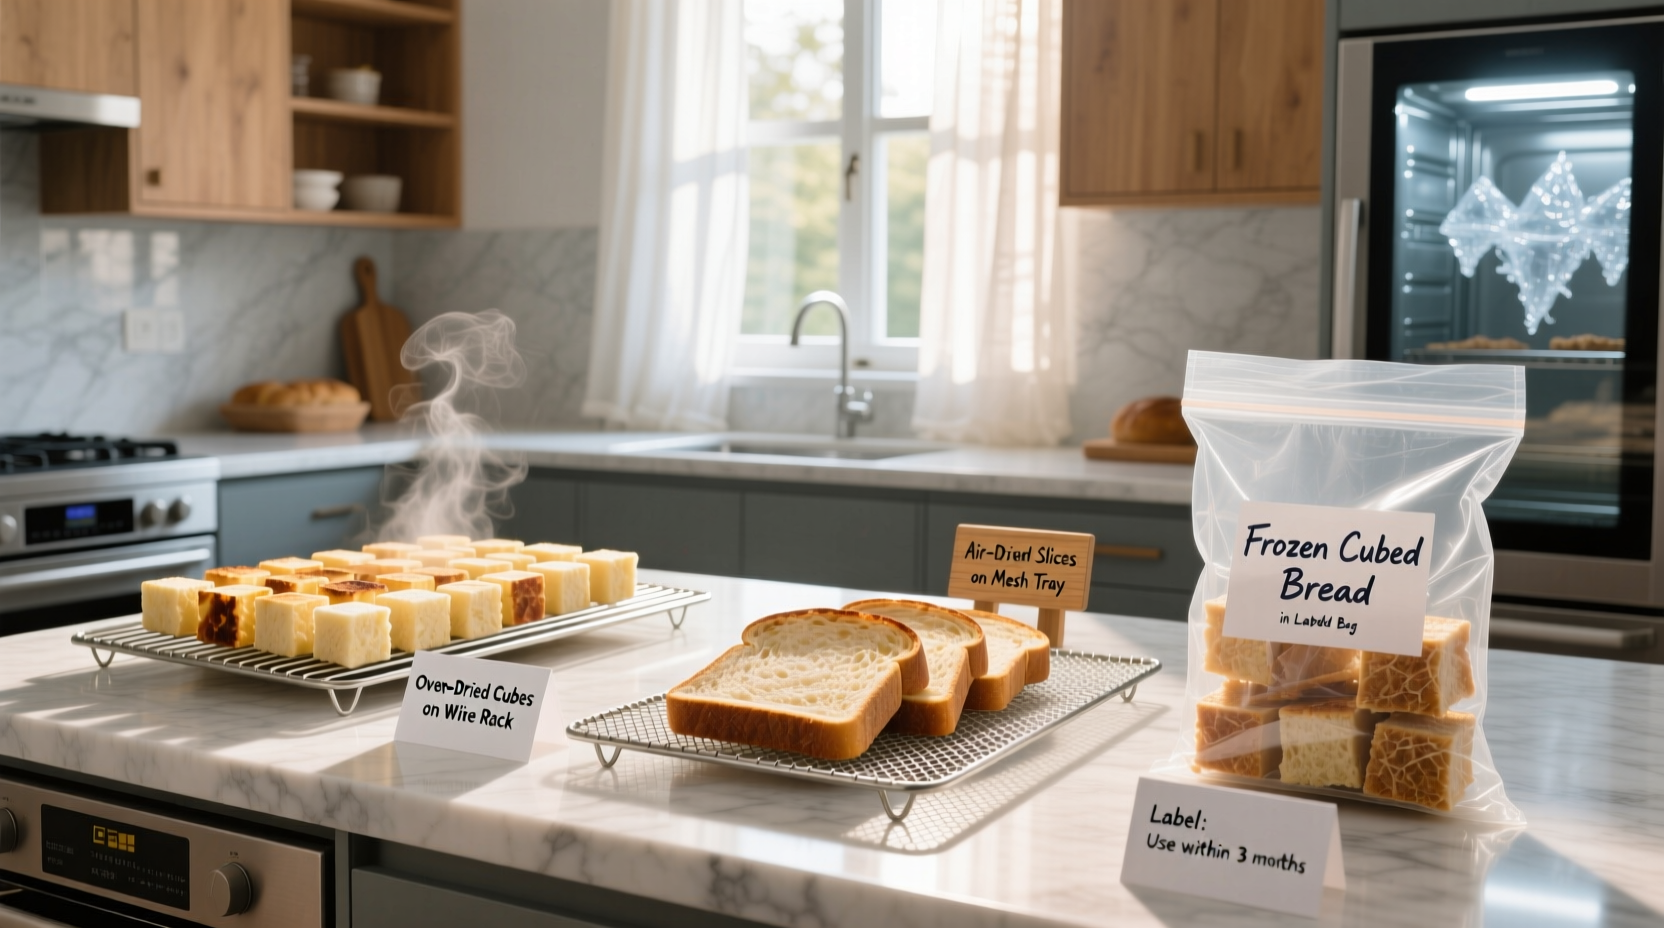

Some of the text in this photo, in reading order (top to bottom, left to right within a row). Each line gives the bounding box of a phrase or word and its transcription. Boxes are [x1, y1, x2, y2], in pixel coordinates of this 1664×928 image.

[1035, 546, 1077, 567] Slices
[1243, 523, 1425, 567] Frozen Cubed
[970, 569, 1065, 598] on Mesh Tray
[1280, 567, 1376, 606] Bread
[1280, 611, 1290, 625] in
[415, 674, 535, 707] Over-Dried Cubes
[422, 704, 440, 718] on
[479, 708, 515, 730] Rack
[1150, 804, 1207, 831] Label:
[1147, 832, 1176, 852] Use
[1182, 839, 1230, 861] within
[1237, 846, 1247, 863] 3
